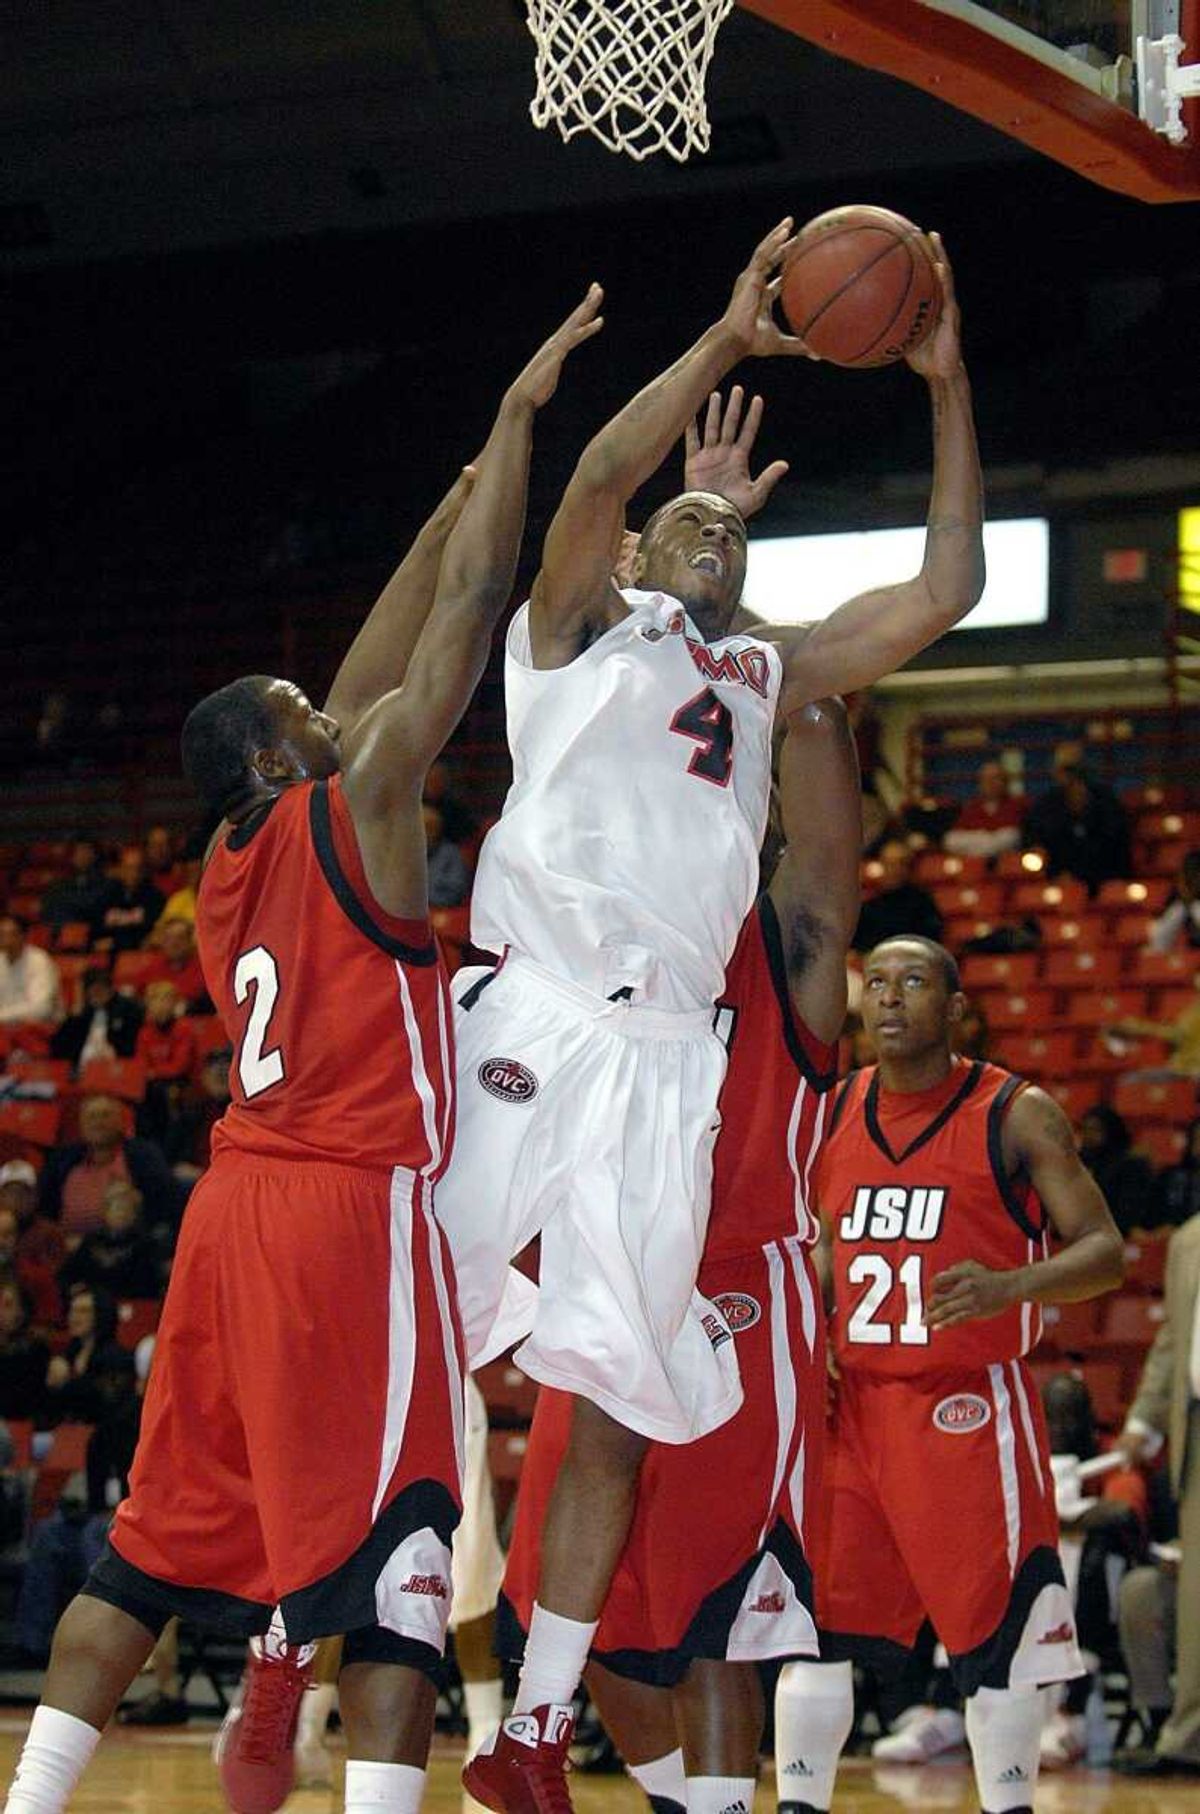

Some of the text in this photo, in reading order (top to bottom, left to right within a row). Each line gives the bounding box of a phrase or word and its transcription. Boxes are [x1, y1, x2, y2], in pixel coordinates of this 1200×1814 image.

[669, 685, 733, 788] 4
[233, 944, 286, 1100] 2
[839, 1184, 948, 1243] JSU
[847, 1253, 930, 1346] 21
